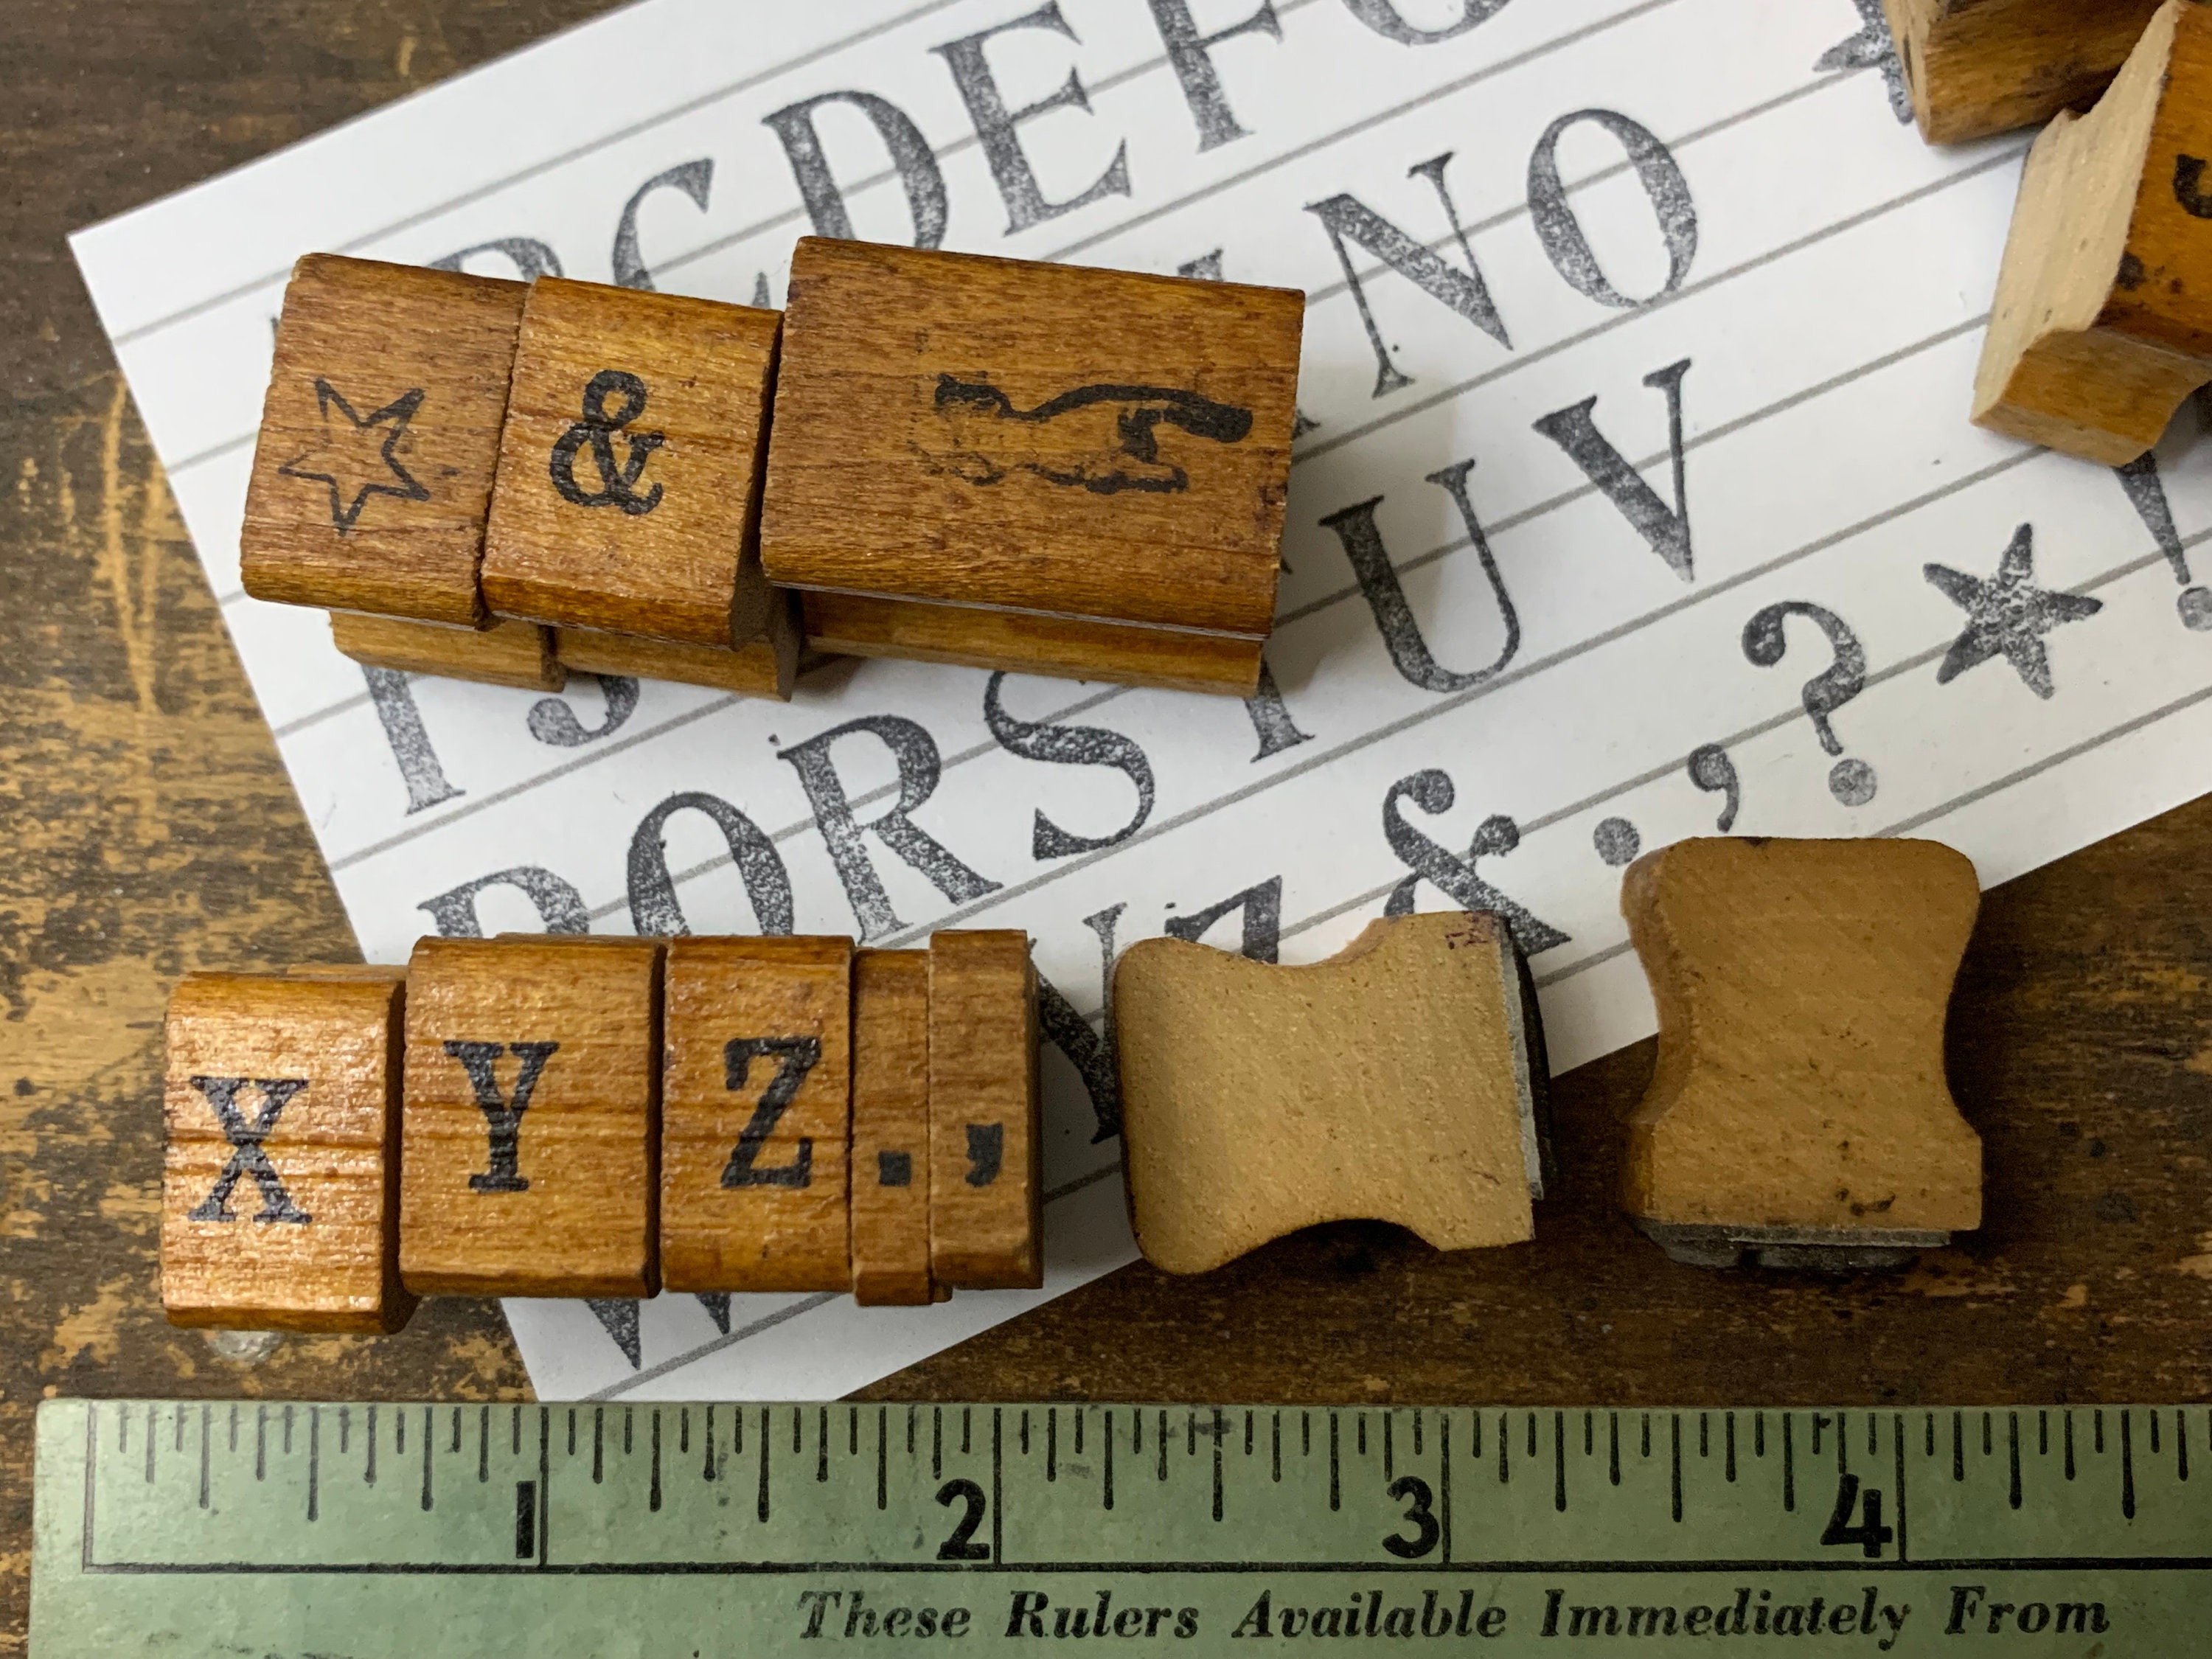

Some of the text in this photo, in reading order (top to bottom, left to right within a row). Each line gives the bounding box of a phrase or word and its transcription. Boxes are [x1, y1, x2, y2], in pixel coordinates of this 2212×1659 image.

[549, 369, 664, 515] &
[187, 1075, 313, 1224] X
[444, 1040, 560, 1192] Y
[721, 1037, 822, 1189] Z
[935, 1478, 991, 1561] 2
[1381, 1475, 1441, 1559] 3
[1819, 1474, 1893, 1558] 4
[799, 1585, 2111, 1651] These Rulers Available Immediately From
